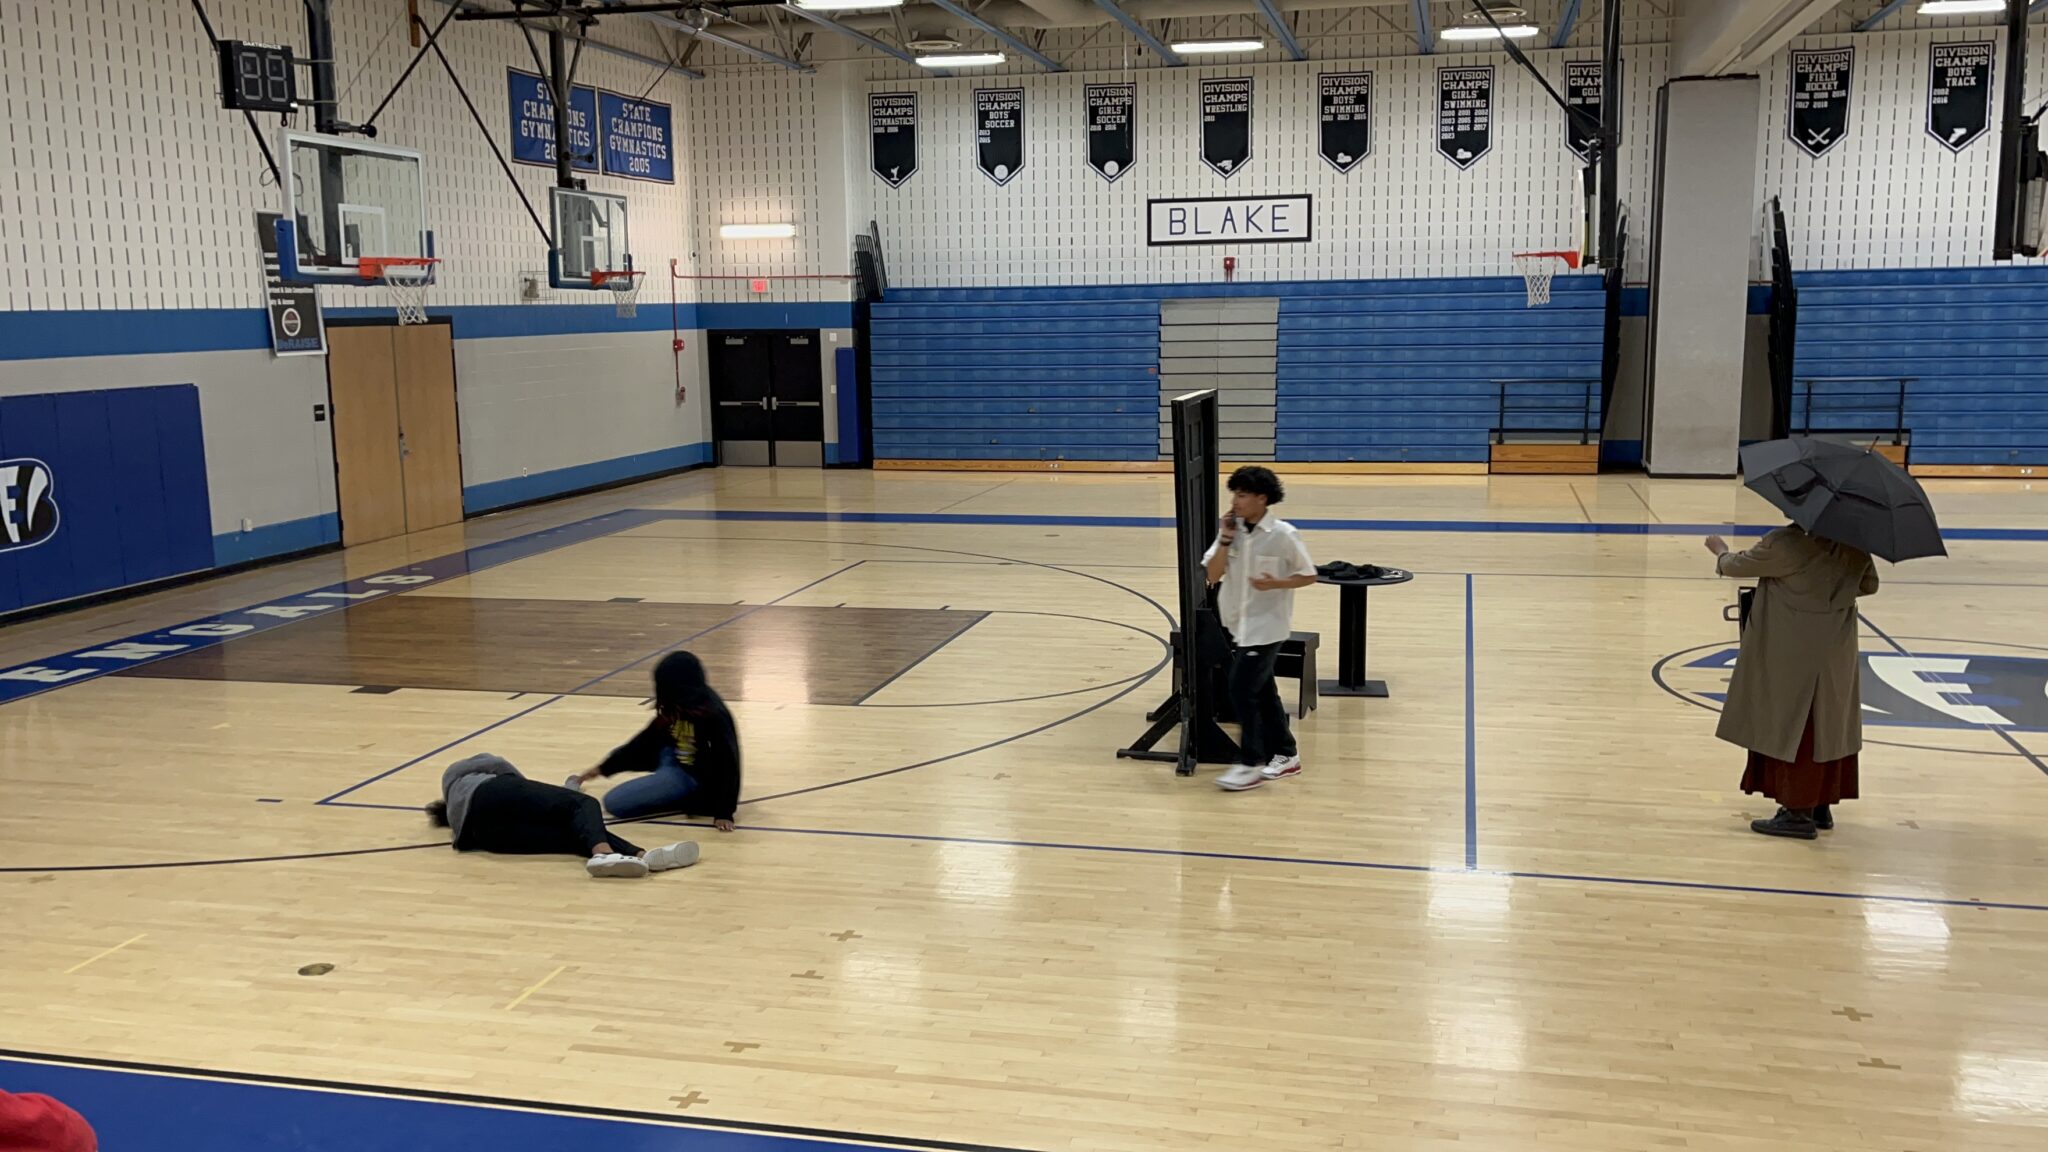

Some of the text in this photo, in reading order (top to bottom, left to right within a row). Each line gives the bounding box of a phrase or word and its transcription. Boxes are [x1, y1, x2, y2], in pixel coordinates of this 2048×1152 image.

[1935, 46, 1989, 57] DIVISION
[1797, 53, 1849, 64] DIVISION
[1935, 55, 1988, 67] CHAMPS
[1797, 62, 1849, 73] CHAMPS
[1442, 71, 1490, 81] DIVISION
[1809, 72, 1837, 82] FIELD
[1322, 76, 1368, 87] DIVISION
[1442, 80, 1489, 90] CHAMPS
[1805, 81, 1839, 91] HOCKEY
[1945, 76, 1977, 87] TRACK
[1089, 87, 1132, 97] DIVISION
[1203, 83, 1248, 93] DIVISION
[1322, 85, 1368, 96] CHAMPS
[873, 97, 913, 106] DIVISION
[978, 92, 1020, 102] DIVISION
[1089, 96, 1132, 106] CHAMPS
[1204, 93, 1248, 103] CHAMPS
[978, 101, 1020, 111] CHAMPS
[1204, 103, 1248, 113] WRESTLING
[1323, 104, 1366, 114] SWIMMING
[1444, 99, 1487, 109] SWIMMING
[622, 103, 651, 122] STATE
[873, 107, 913, 116] CHAMPS
[873, 117, 914, 126] GYMNASTICS
[985, 119, 1015, 129] SOCCER
[1096, 115, 1126, 124] SOCCER
[611, 117, 663, 142] CHAMPIONS
[1473, 123, 1487, 131] 2017
[609, 134, 667, 160] GYMNASTICS
[629, 156, 650, 173] 2005
[1169, 204, 1290, 235] BLAKE
